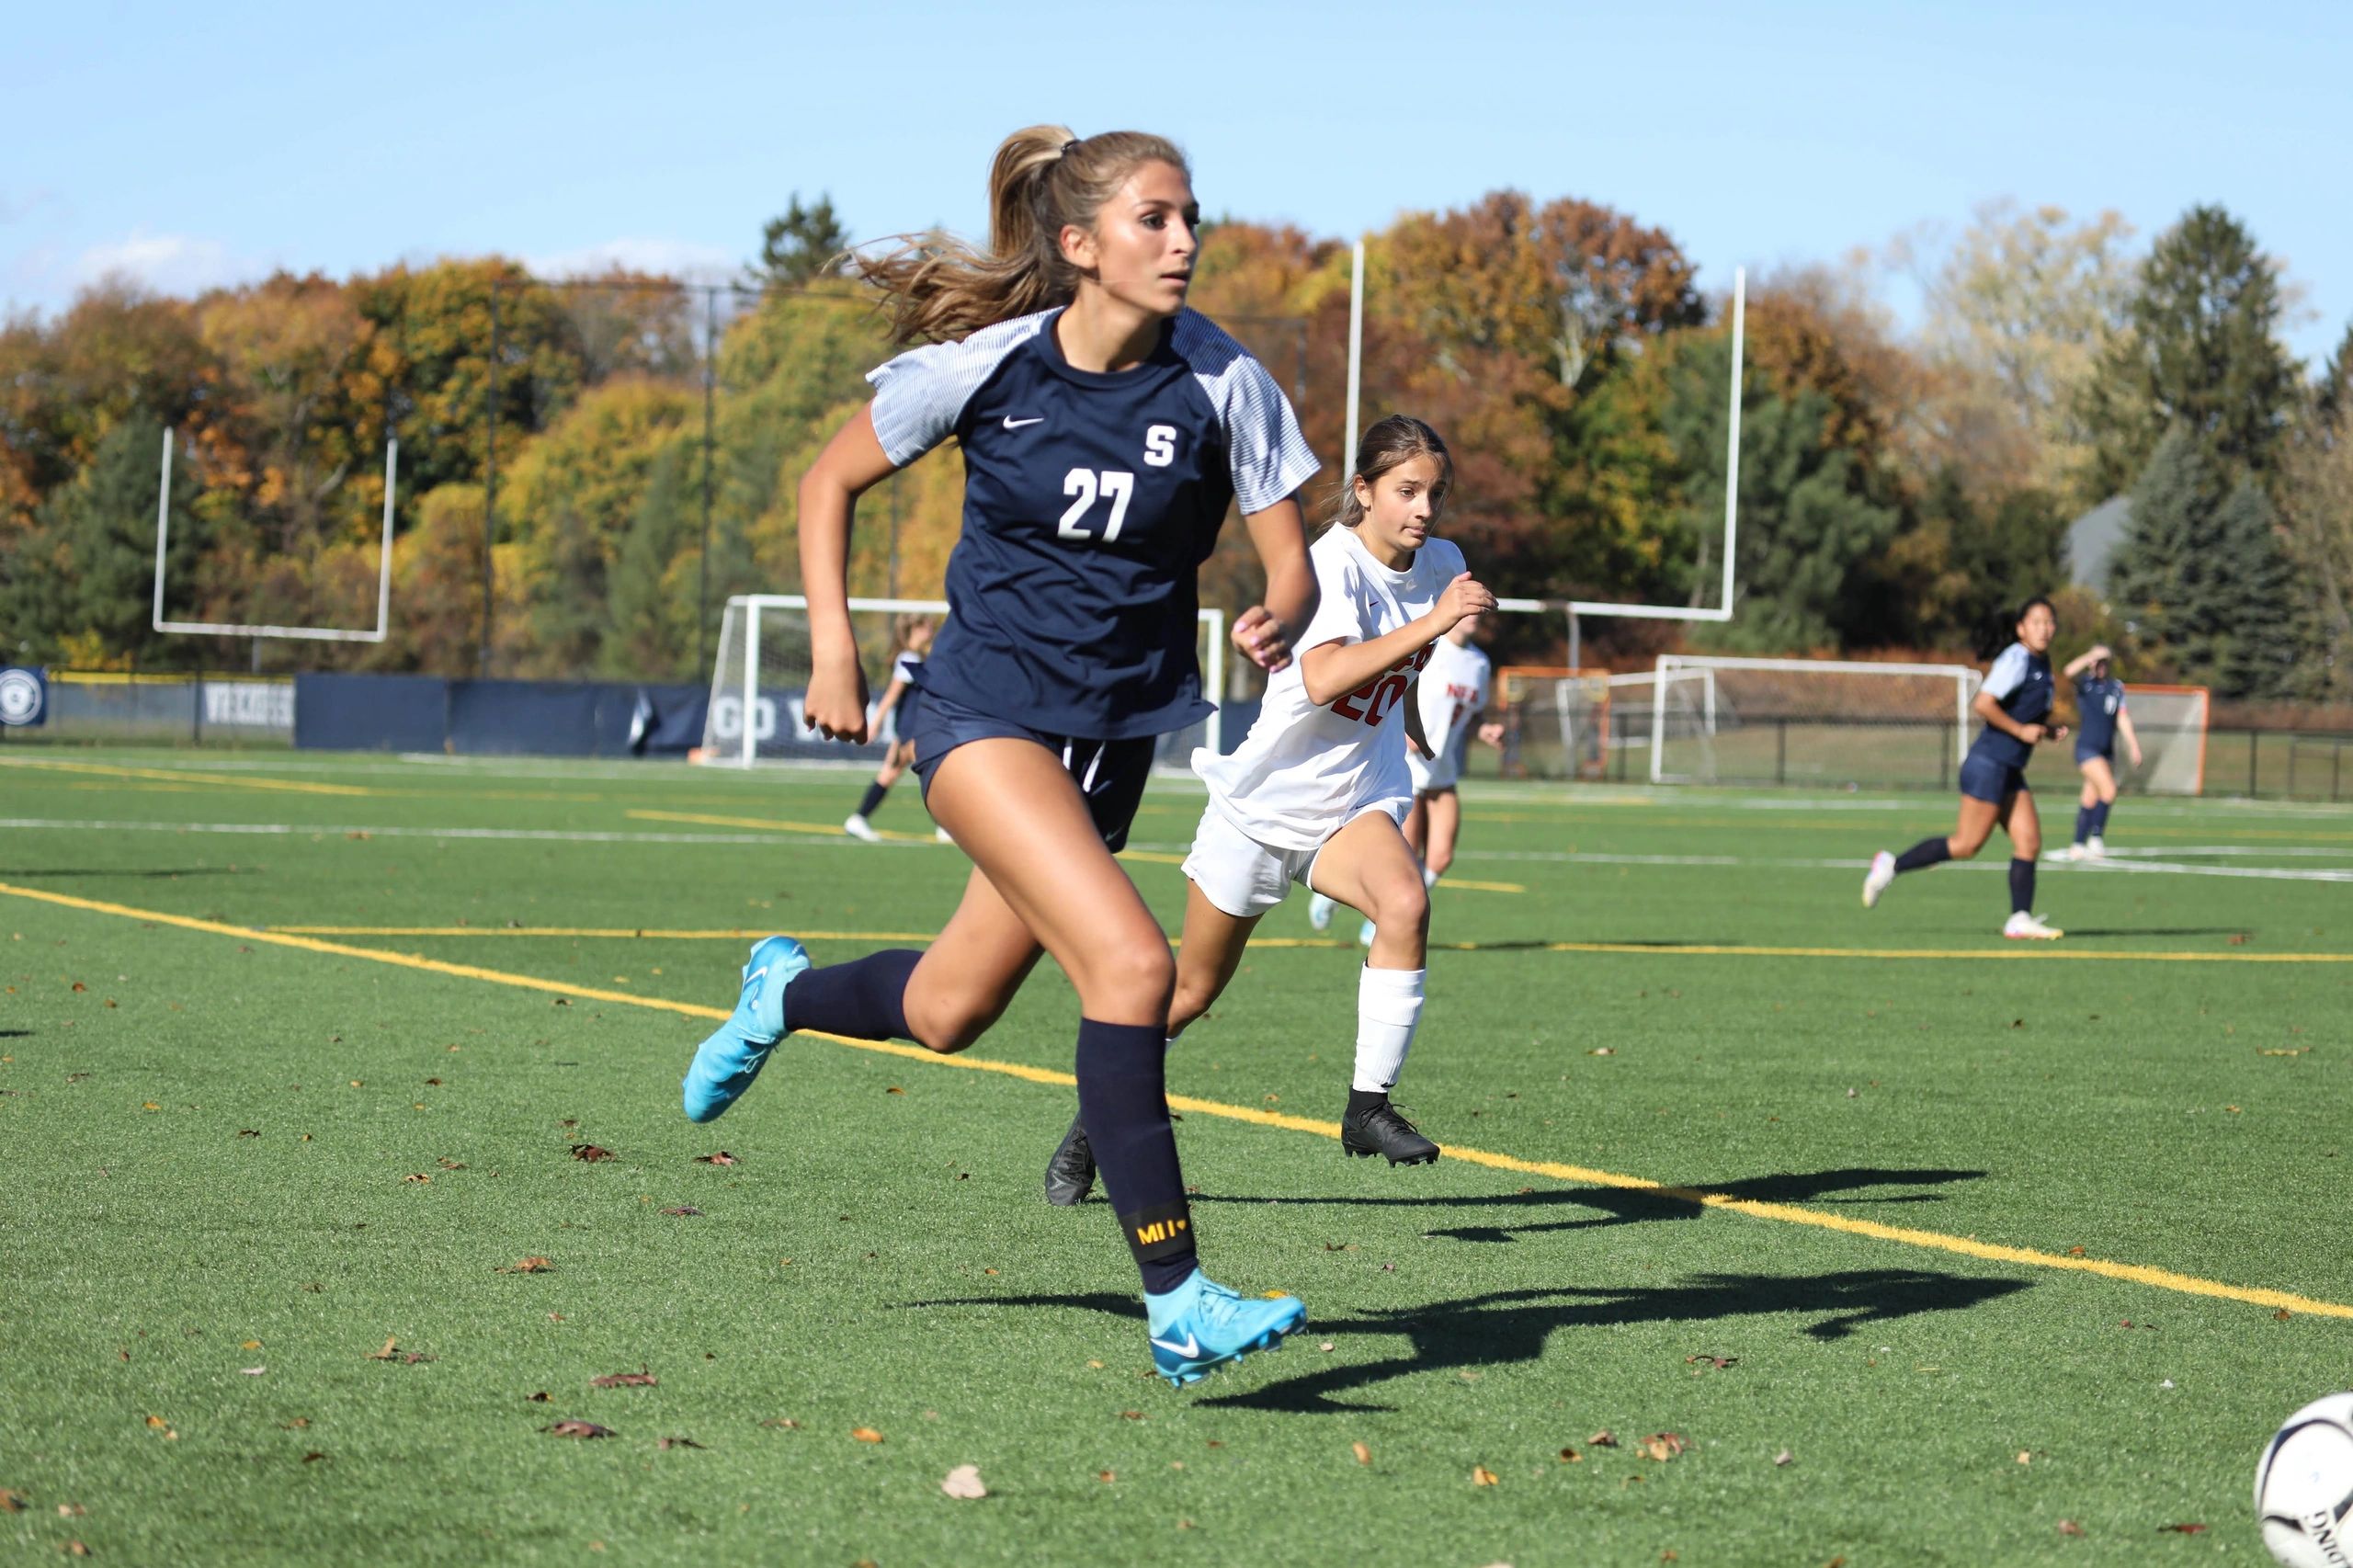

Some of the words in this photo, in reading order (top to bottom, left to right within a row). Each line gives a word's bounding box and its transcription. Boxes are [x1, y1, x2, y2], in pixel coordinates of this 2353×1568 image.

[1143, 425, 1176, 467] S
[1057, 468, 1134, 543] 27
[713, 696, 776, 740] GO
[2304, 1510, 2351, 1568] DING
